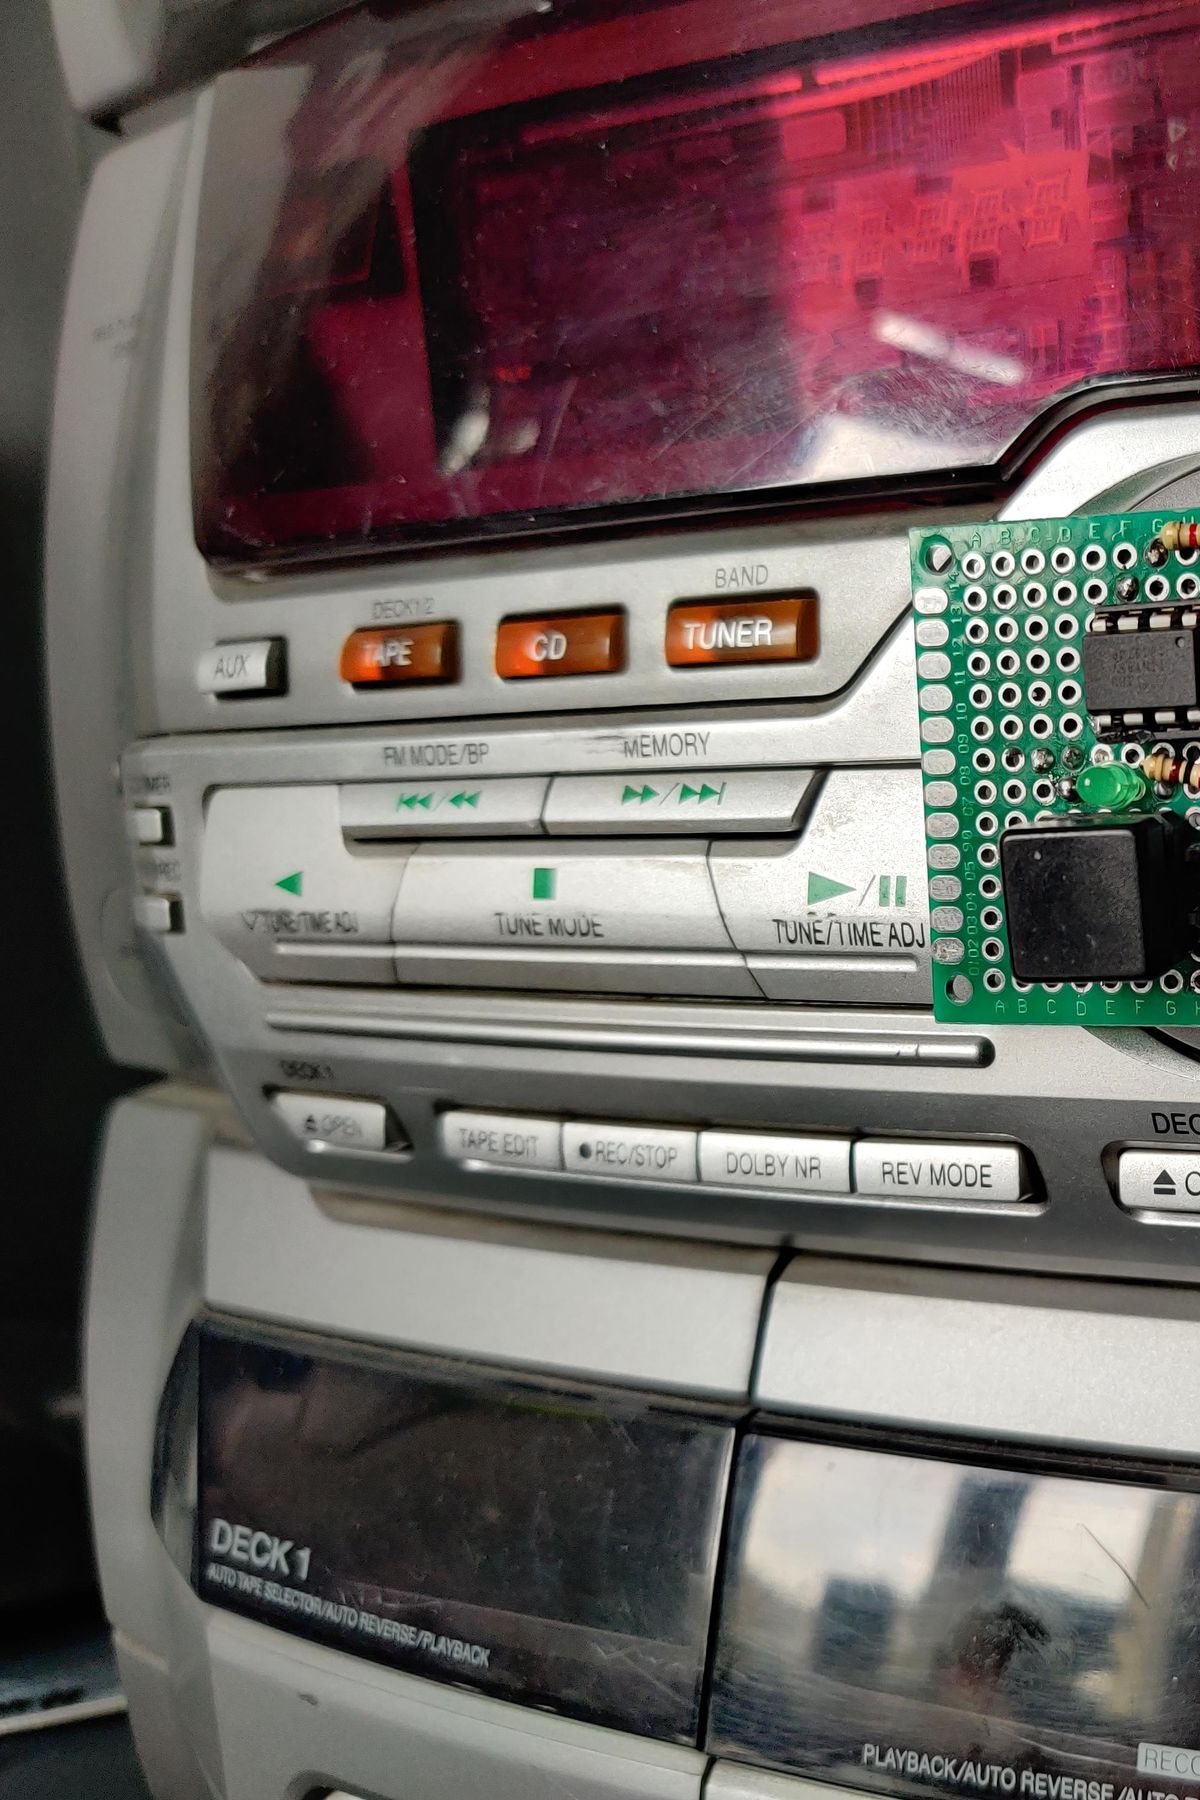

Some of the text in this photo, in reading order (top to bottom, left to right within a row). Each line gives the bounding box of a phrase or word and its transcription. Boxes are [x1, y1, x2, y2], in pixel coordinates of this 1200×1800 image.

[715, 564, 768, 589] BAND
[529, 630, 568, 662] CD
[684, 619, 773, 650] TUNER
[214, 654, 249, 679] AUX
[408, 742, 489, 766] MODE/BP
[623, 732, 711, 758] MEMORY
[494, 911, 604, 938] TUNE MODE
[772, 919, 926, 948] TUNE/TIME ADJ
[458, 1128, 539, 1158] TAPE EDIT
[595, 1140, 678, 1169] REC/STOP
[726, 1151, 821, 1180] DOLBY NR
[881, 1161, 993, 1188] REV MODE
[210, 1517, 312, 1581] DECK 1
[207, 1562, 490, 1668] AUTO TAPE SELECTOR/AUTO REVERSE/PLAYBACK
[861, 1743, 1017, 1790] PLAYBACK/AUTO
[1020, 1769, 1114, 1800] REVERSE
